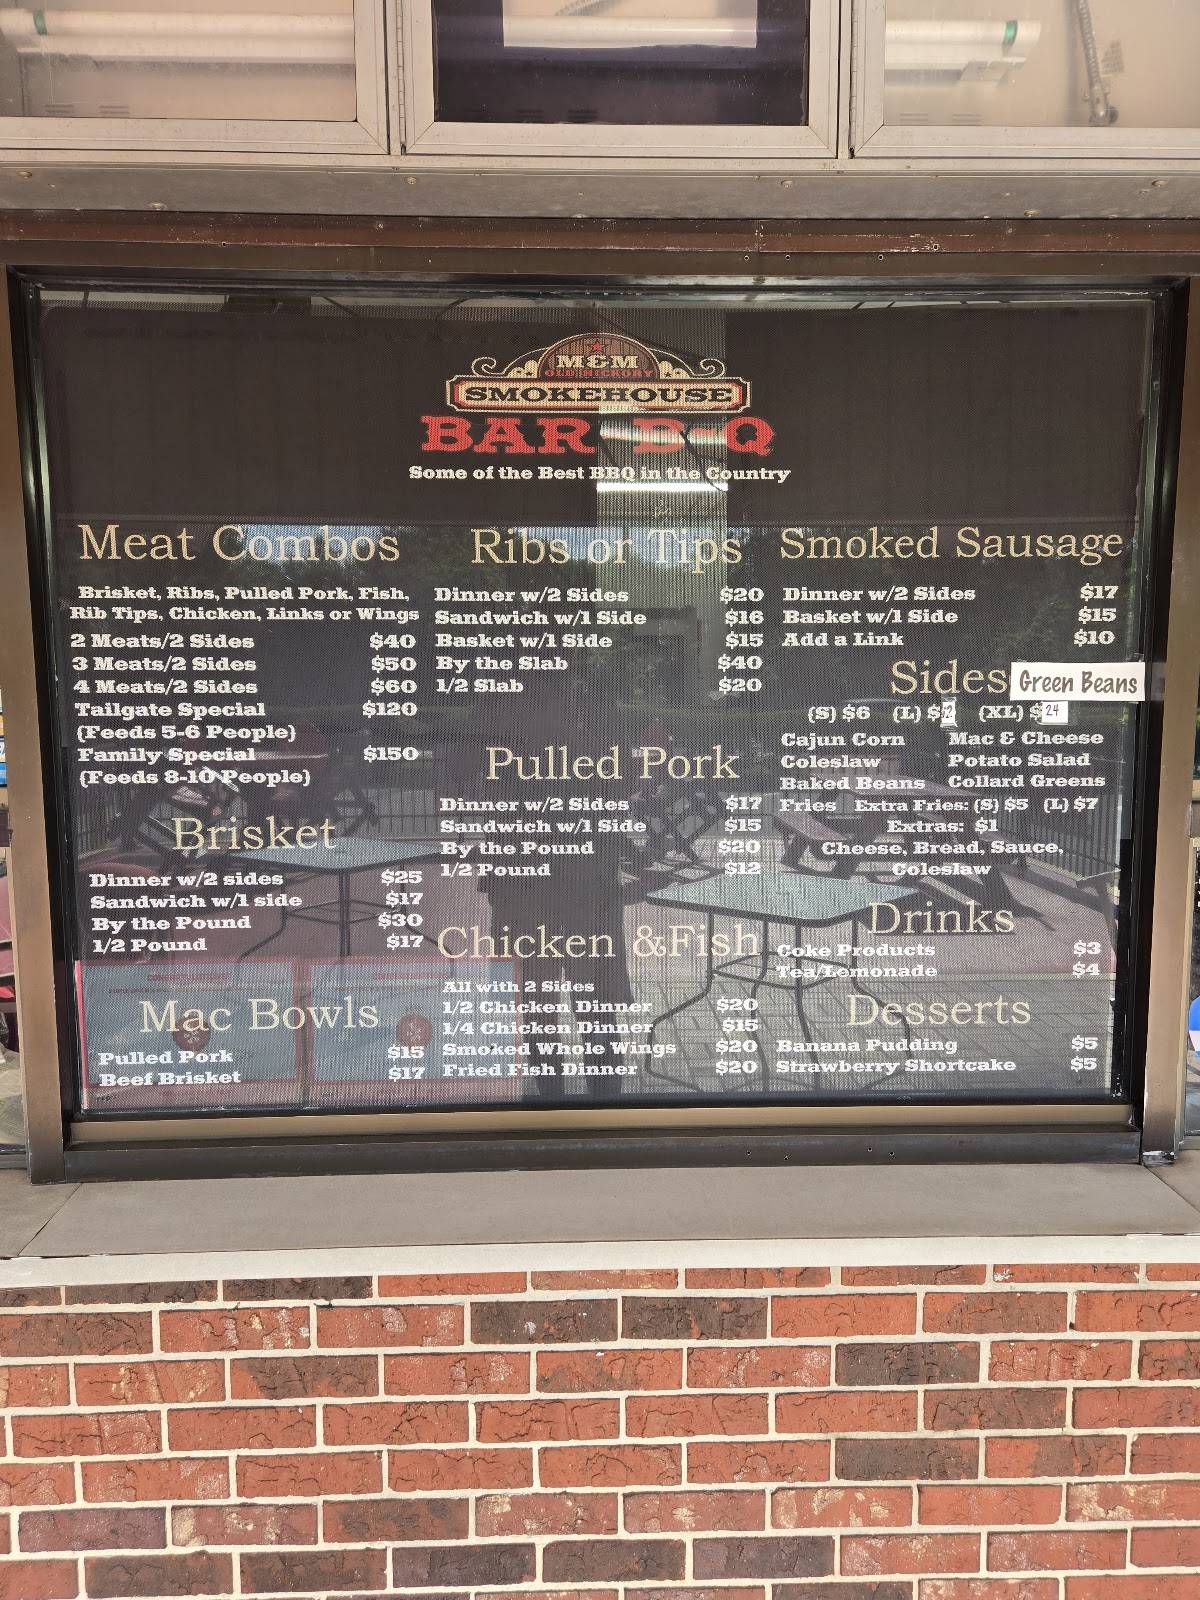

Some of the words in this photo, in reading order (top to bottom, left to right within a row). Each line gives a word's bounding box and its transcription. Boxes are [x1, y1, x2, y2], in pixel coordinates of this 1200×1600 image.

[555, 355, 639, 369] M&M
[545, 369, 576, 377] OLD
[583, 369, 654, 377] HICKORY
[465, 387, 732, 402] SMOKEHOUSE
[409, 466, 467, 479] Some
[473, 466, 495, 479] of
[498, 466, 534, 479] the
[538, 466, 585, 480] Best
[589, 466, 635, 481] BBQ
[641, 466, 662, 480] in
[666, 466, 701, 480] the
[706, 466, 791, 483] Country
[78, 524, 195, 560] Meat
[213, 524, 400, 561] Combos
[471, 529, 570, 564] Ribs
[588, 536, 632, 564] or
[650, 529, 742, 574] Tips
[781, 526, 939, 559] Smoked
[956, 526, 1123, 566] Sausage
[78, 587, 162, 601] Brisket,
[166, 587, 220, 601] Ribs,
[225, 587, 293, 600] Pulled
[298, 587, 353, 601] Pork,
[359, 587, 410, 601] Fish,
[434, 588, 515, 602] Dinner
[521, 587, 561, 604] w/2
[567, 587, 628, 602] Sides
[720, 586, 763, 604] $20
[783, 587, 862, 601] Dinner
[869, 586, 909, 602] w/2
[914, 586, 976, 601] Sides
[1081, 584, 1118, 602] $17
[70, 607, 106, 620] Rib
[112, 607, 163, 623] Tips,
[169, 607, 261, 622] Chicken,
[266, 608, 324, 620] Links
[330, 610, 351, 620] or
[356, 608, 419, 624] Wings
[435, 611, 548, 624] Sandwich
[555, 609, 591, 626] w/1
[597, 611, 647, 624] Side
[725, 609, 764, 627] $16
[783, 610, 860, 624] Basket
[867, 609, 902, 625] w/1
[908, 609, 958, 624] Side
[1078, 607, 1116, 625] $15
[71, 635, 85, 648] 2
[92, 633, 184, 650] Meats/2
[190, 634, 254, 648] Sides
[370, 632, 415, 650] $40
[782, 632, 828, 647] Add
[834, 636, 848, 646] a
[854, 632, 904, 646] Link
[1074, 630, 1115, 648] $10
[436, 656, 469, 674] By
[475, 656, 513, 670] the
[519, 656, 568, 670] Slab
[718, 653, 762, 671] $40
[437, 678, 468, 693] 1/2
[474, 678, 523, 692] Slab
[718, 677, 762, 694] $20
[891, 659, 1008, 695] Sides
[1020, 669, 1073, 692] Green
[1082, 670, 1138, 693] Beans
[74, 680, 89, 693] 4
[96, 679, 188, 695] Meats/2
[194, 679, 257, 694] Sides
[371, 678, 417, 696] $60
[75, 703, 172, 720] Tailgate
[178, 702, 265, 720] Special
[363, 701, 418, 718] $120
[808, 706, 836, 723] (S)
[842, 704, 870, 723] $6
[893, 706, 921, 723] (L)
[979, 705, 1023, 723] (XL)
[77, 726, 156, 742] (Feeds
[161, 726, 200, 739] 5-6
[206, 724, 296, 742] People)
[781, 732, 846, 749] Cajun
[852, 732, 905, 746] Corn
[949, 732, 994, 746] Mac
[1000, 732, 1015, 745] &
[1022, 731, 1104, 744] Cheese
[486, 746, 622, 780] Pulled
[640, 745, 740, 779] Pork
[781, 754, 881, 769] Coleslaw
[948, 753, 1022, 768] Potato
[1028, 752, 1090, 767] Salad
[780, 777, 850, 791] Baked
[856, 776, 925, 791] Beans
[948, 774, 1024, 788] Collard
[1029, 774, 1105, 788] Greens
[779, 799, 836, 812] Fries
[854, 799, 908, 813] Extra
[912, 798, 968, 812] Fries:
[974, 798, 999, 814] (S)
[1004, 797, 1028, 813] $5
[1044, 798, 1068, 813] (L)
[1074, 796, 1098, 812] $7
[172, 816, 336, 850] Brisket
[887, 819, 964, 834] Extras:
[975, 818, 999, 833] $1
[822, 841, 908, 856] Cheese,
[913, 841, 984, 855] Bread,
[991, 840, 1064, 855] Sauce,
[90, 873, 171, 887] Dinner
[177, 872, 218, 887] w/2
[223, 872, 283, 886] sides
[381, 869, 422, 886] $25
[892, 862, 991, 877] Coleslaw
[91, 895, 207, 909] Sandwich
[212, 894, 249, 909] w/1
[254, 894, 302, 907] side
[386, 891, 423, 908] $17
[868, 899, 1014, 934] Drinks
[437, 925, 616, 959] Chicken
[777, 944, 831, 958] Coke
[837, 943, 935, 958] Products
[1073, 939, 1101, 957] $3
[443, 981, 471, 993] All
[476, 981, 519, 993] with
[525, 981, 536, 993] 2
[541, 980, 594, 993] Sides
[139, 1000, 232, 1033] Mac
[249, 996, 378, 1030] Bowls
[443, 1001, 474, 1015] 1/2
[480, 1000, 571, 1014] Chicken
[576, 1000, 651, 1013] Dinner
[717, 997, 758, 1014] $20
[848, 994, 1031, 1026] Desserts
[776, 1039, 860, 1053] Banana
[866, 1038, 958, 1054] Pudding
[1071, 1035, 1098, 1052] $5
[99, 1051, 173, 1065] Pulled
[178, 1050, 233, 1064] Pork
[388, 1045, 424, 1061] $15
[443, 1063, 503, 1077] Fried
[508, 1063, 556, 1076] Fish
[561, 1062, 637, 1075] Dinner
[716, 1059, 758, 1076] $20
[776, 1060, 899, 1076] Strawberry
[905, 1058, 1016, 1072] Shortcake
[1071, 1056, 1098, 1072] $5
[99, 1073, 152, 1086] Beef
[158, 1070, 241, 1084] Brisket
[389, 1067, 425, 1083] $17
